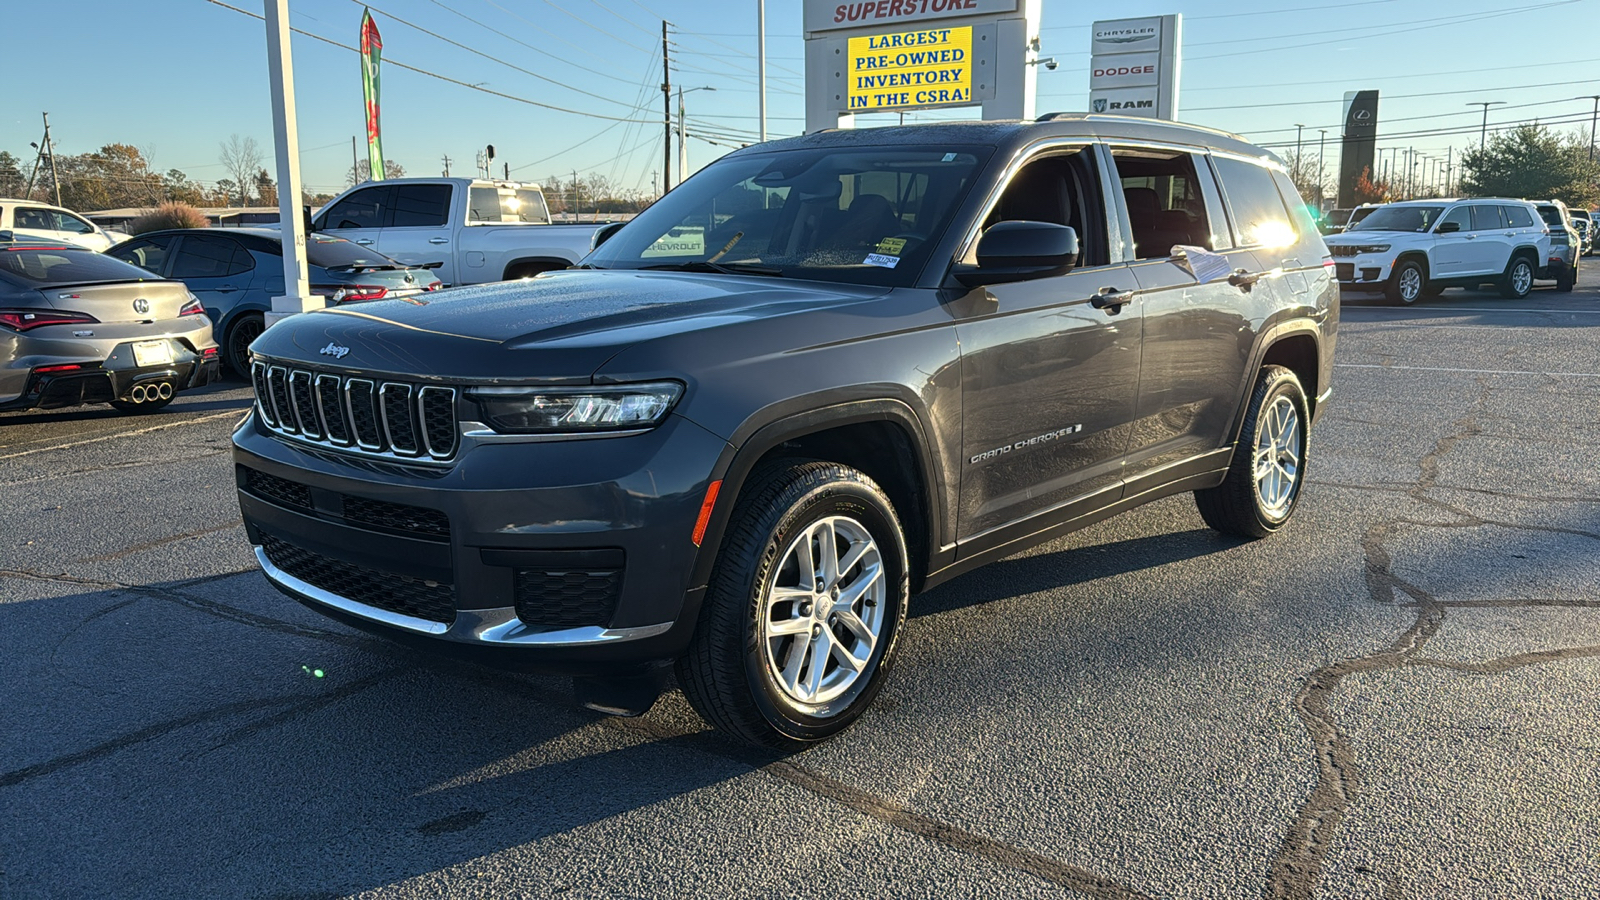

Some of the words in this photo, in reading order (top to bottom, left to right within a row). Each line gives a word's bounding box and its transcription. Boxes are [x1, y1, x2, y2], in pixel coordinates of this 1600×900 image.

[868, 30, 951, 49] LARGEST
[1096, 28, 1155, 37] CHRYSLER
[855, 49, 965, 70] PRE-OWNED
[857, 69, 963, 89] INVENTORY
[1093, 65, 1155, 77] DODGE
[850, 95, 868, 108] IN
[874, 92, 910, 106] THE
[915, 88, 969, 103] CSRA!
[1109, 100, 1153, 110] RAM
[647, 243, 702, 251] HEVROLET
[319, 342, 350, 359] Jeep
[970, 445, 1012, 464] GRAND
[1014, 426, 1073, 450] CHEROKEE
